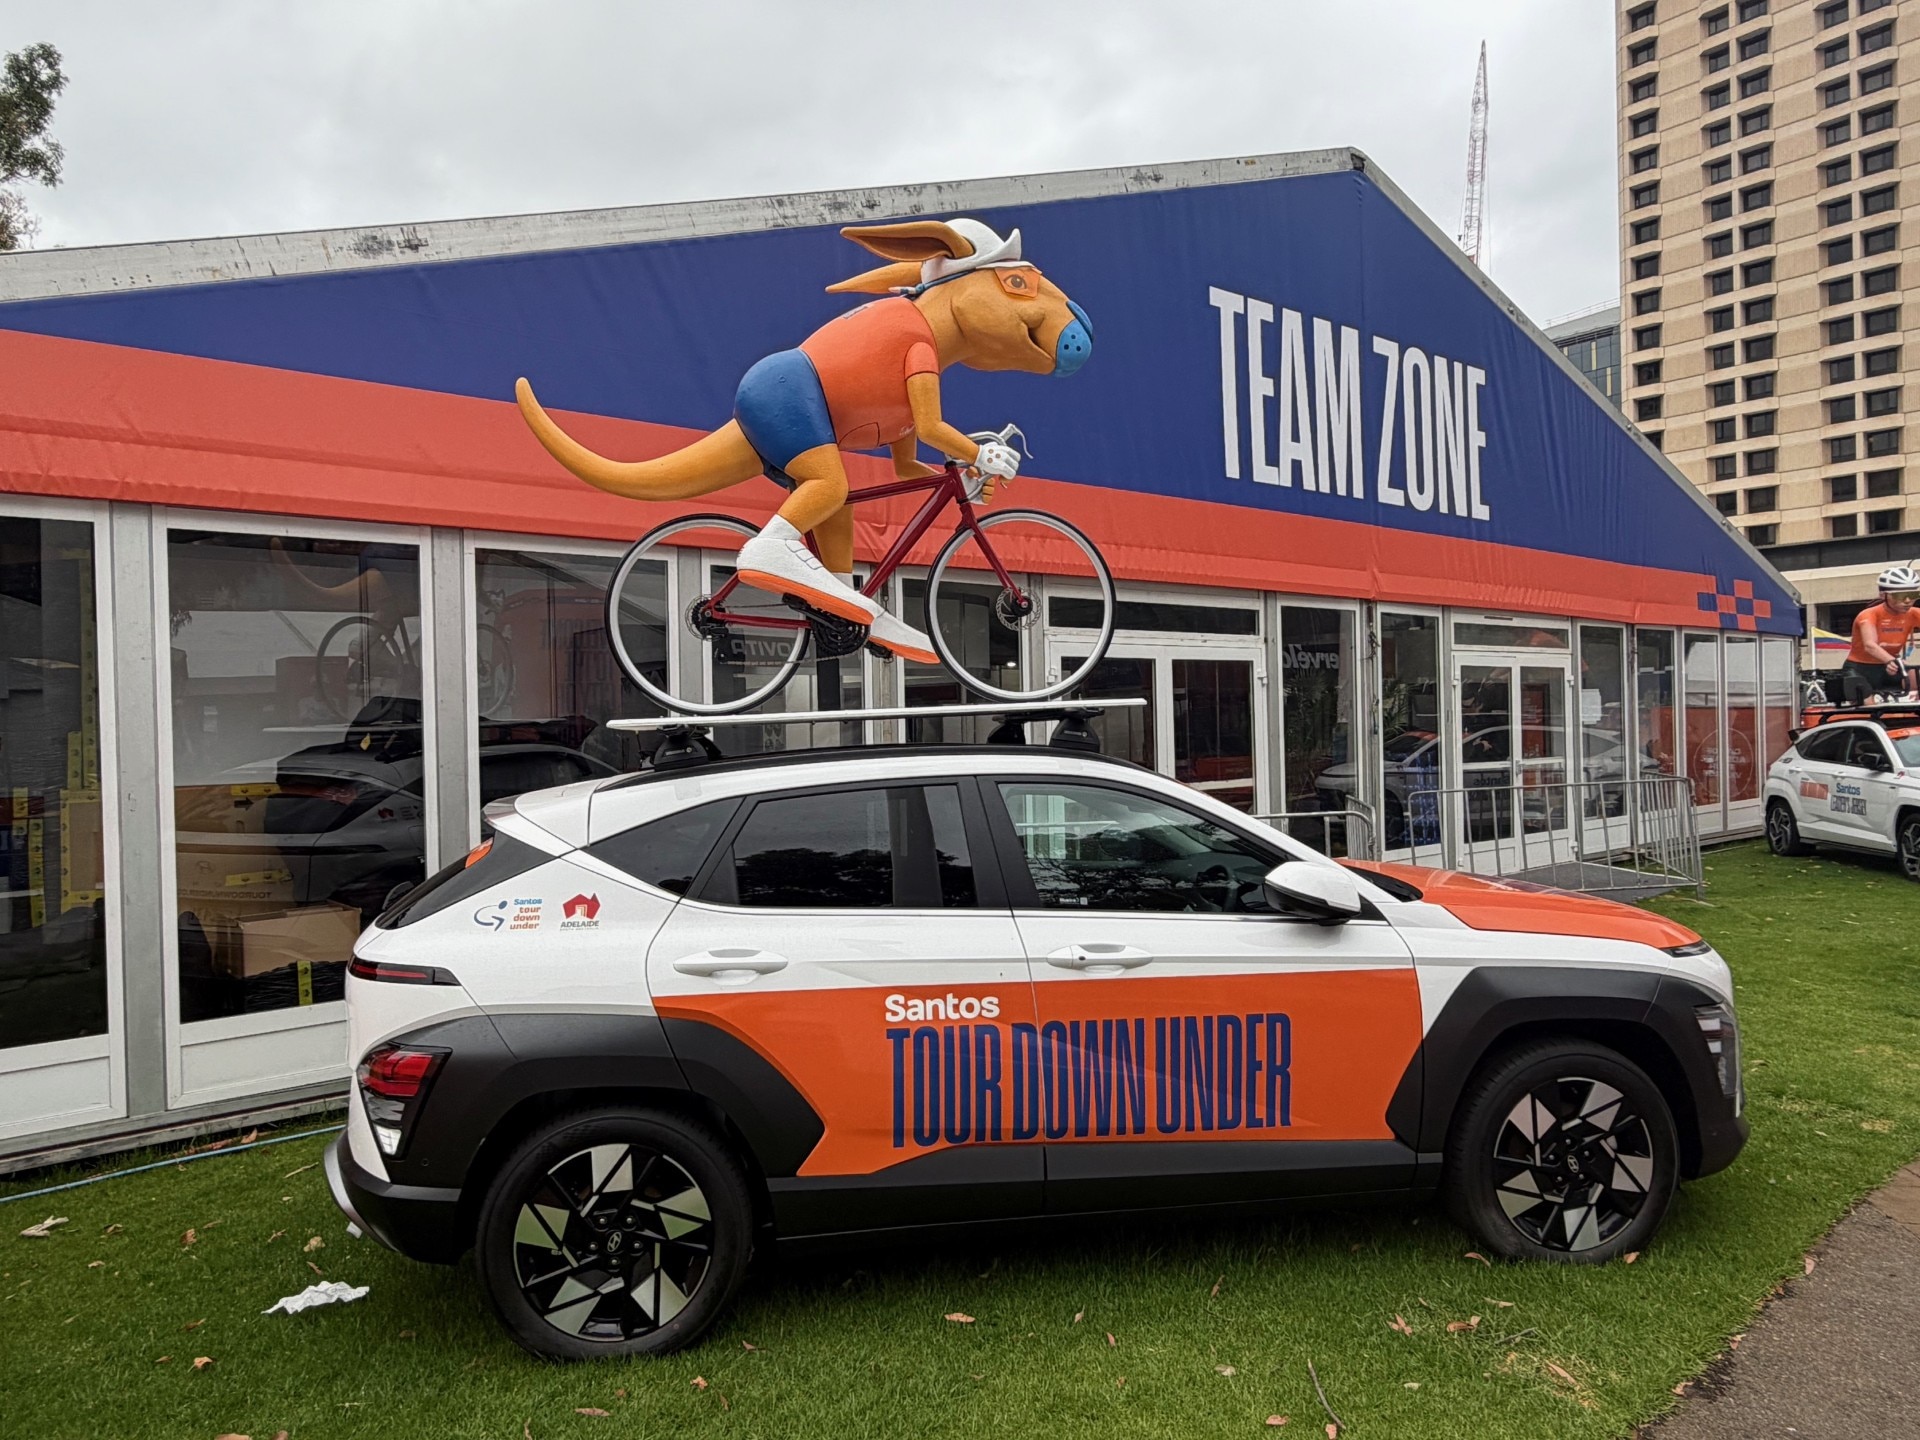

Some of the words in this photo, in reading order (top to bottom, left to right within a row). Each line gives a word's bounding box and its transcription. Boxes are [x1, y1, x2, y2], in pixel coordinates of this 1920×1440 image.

[1209, 286, 1364, 499] TEAM
[1373, 335, 1490, 521] ZONE
[1836, 782, 1861, 796] Santos
[514, 898, 543, 906] Santos
[519, 906, 541, 914] tour
[513, 914, 540, 922] down
[560, 920, 600, 928] ADELAIDE
[885, 993, 1000, 1022] Santos
[886, 1023, 1003, 1148] TOUR
[1011, 1018, 1146, 1141] DOWN
[1154, 1012, 1292, 1134] UNDER
